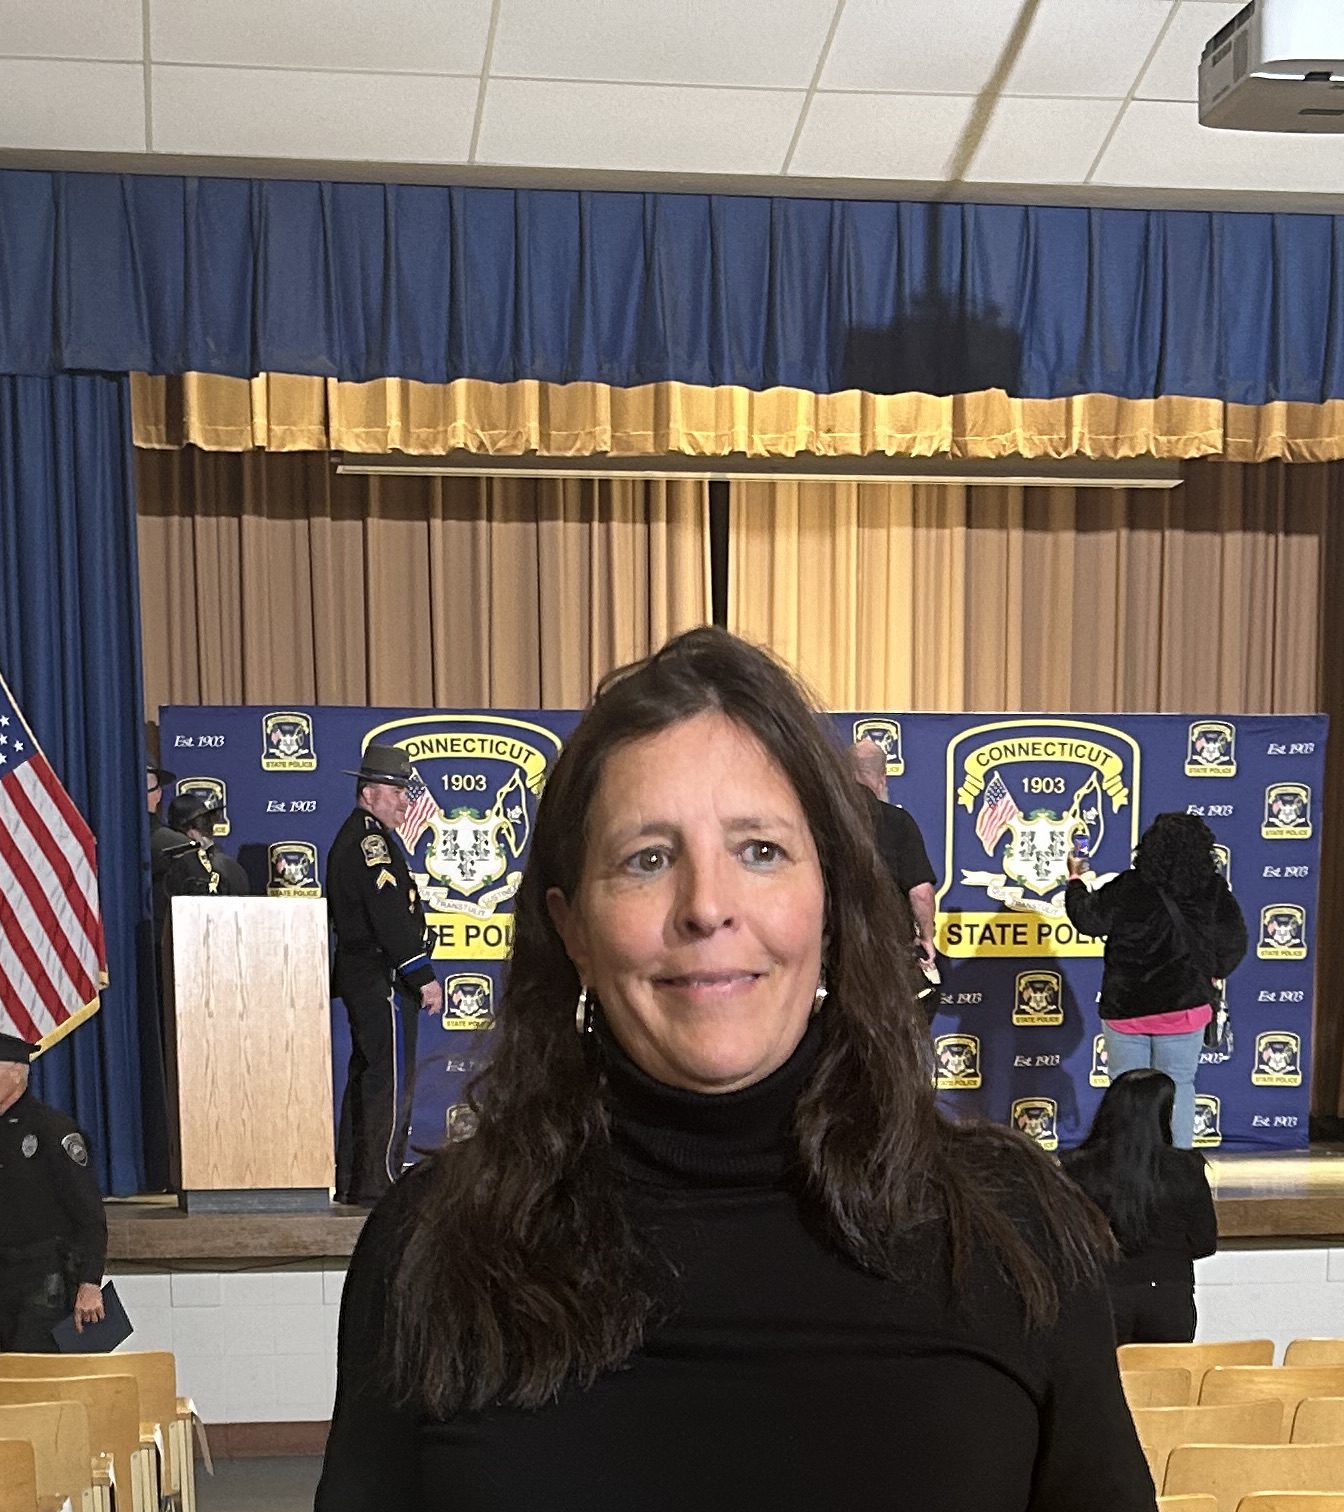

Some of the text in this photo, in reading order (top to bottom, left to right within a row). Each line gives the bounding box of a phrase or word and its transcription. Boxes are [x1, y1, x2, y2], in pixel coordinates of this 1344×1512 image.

[197, 735, 225, 748] 1903
[406, 738, 537, 765] ONNECTICUT
[976, 742, 1114, 768] CONNECTICUT
[441, 774, 487, 792] 1903
[1022, 777, 1065, 794] 1903
[289, 800, 316, 813] 1903
[947, 923, 1028, 945] STATE
